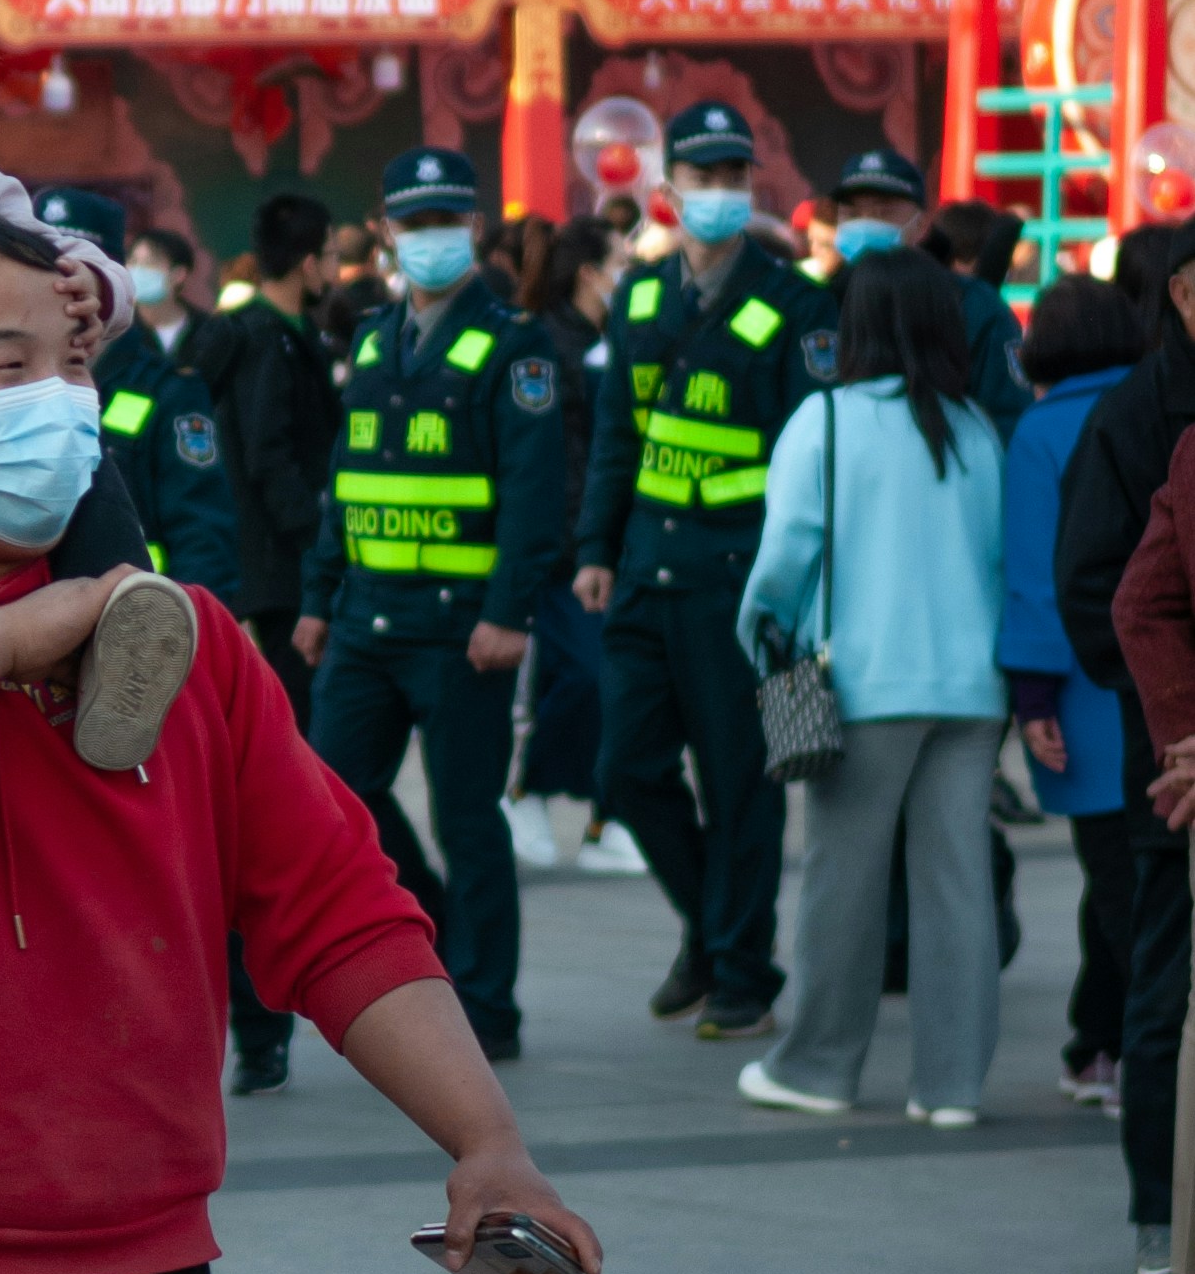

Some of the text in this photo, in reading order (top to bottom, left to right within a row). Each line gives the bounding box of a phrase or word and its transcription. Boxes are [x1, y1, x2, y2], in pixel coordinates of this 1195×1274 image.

[346, 505, 457, 540] GUO DING
[113, 671, 149, 720] ANTA
